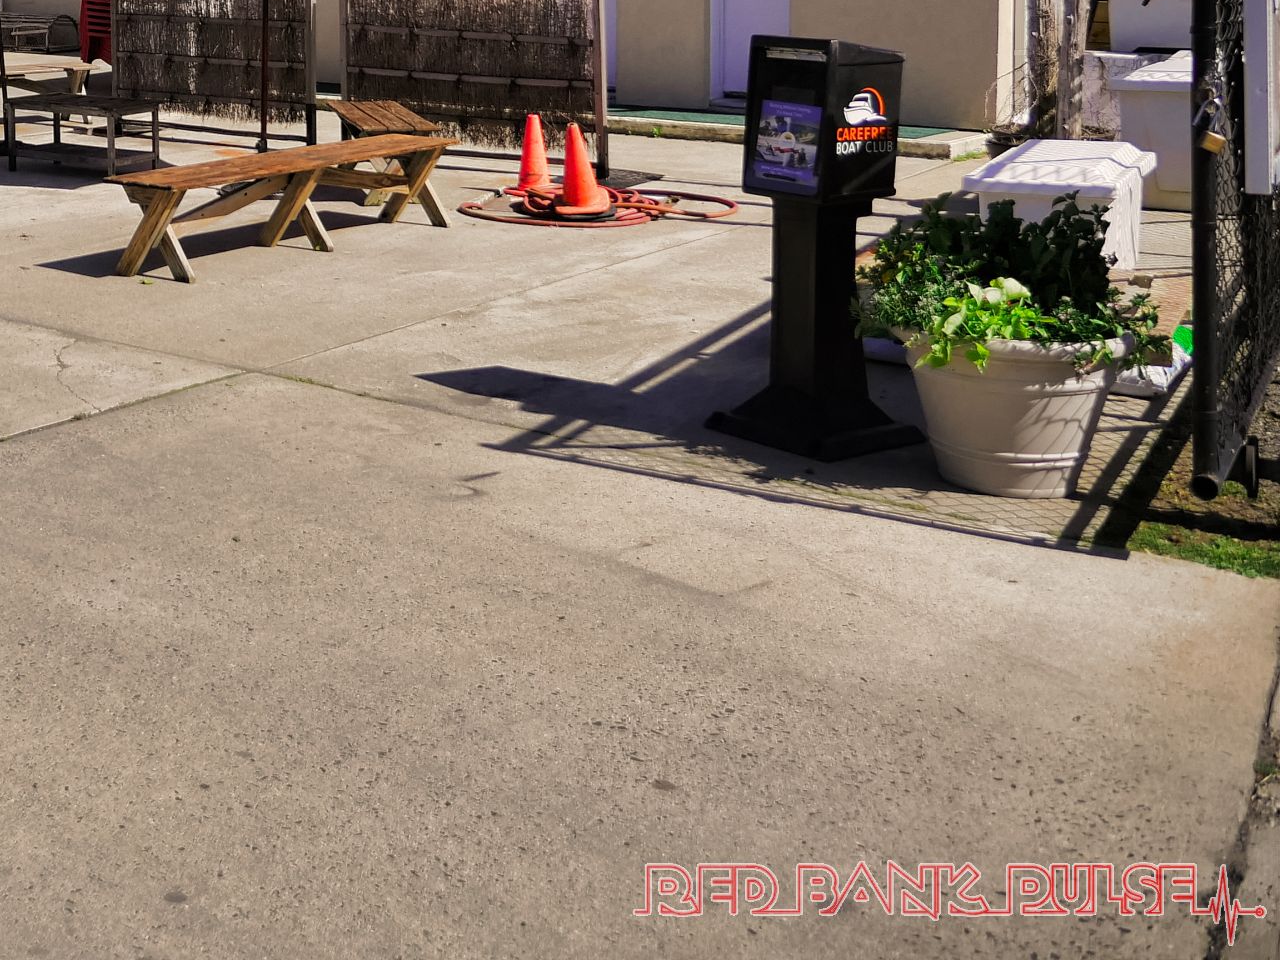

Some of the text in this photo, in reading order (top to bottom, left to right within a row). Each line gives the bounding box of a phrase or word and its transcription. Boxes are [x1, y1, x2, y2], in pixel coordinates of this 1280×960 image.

[836, 126, 893, 141] CAREFREE
[836, 141, 893, 155] BOAT CLUB
